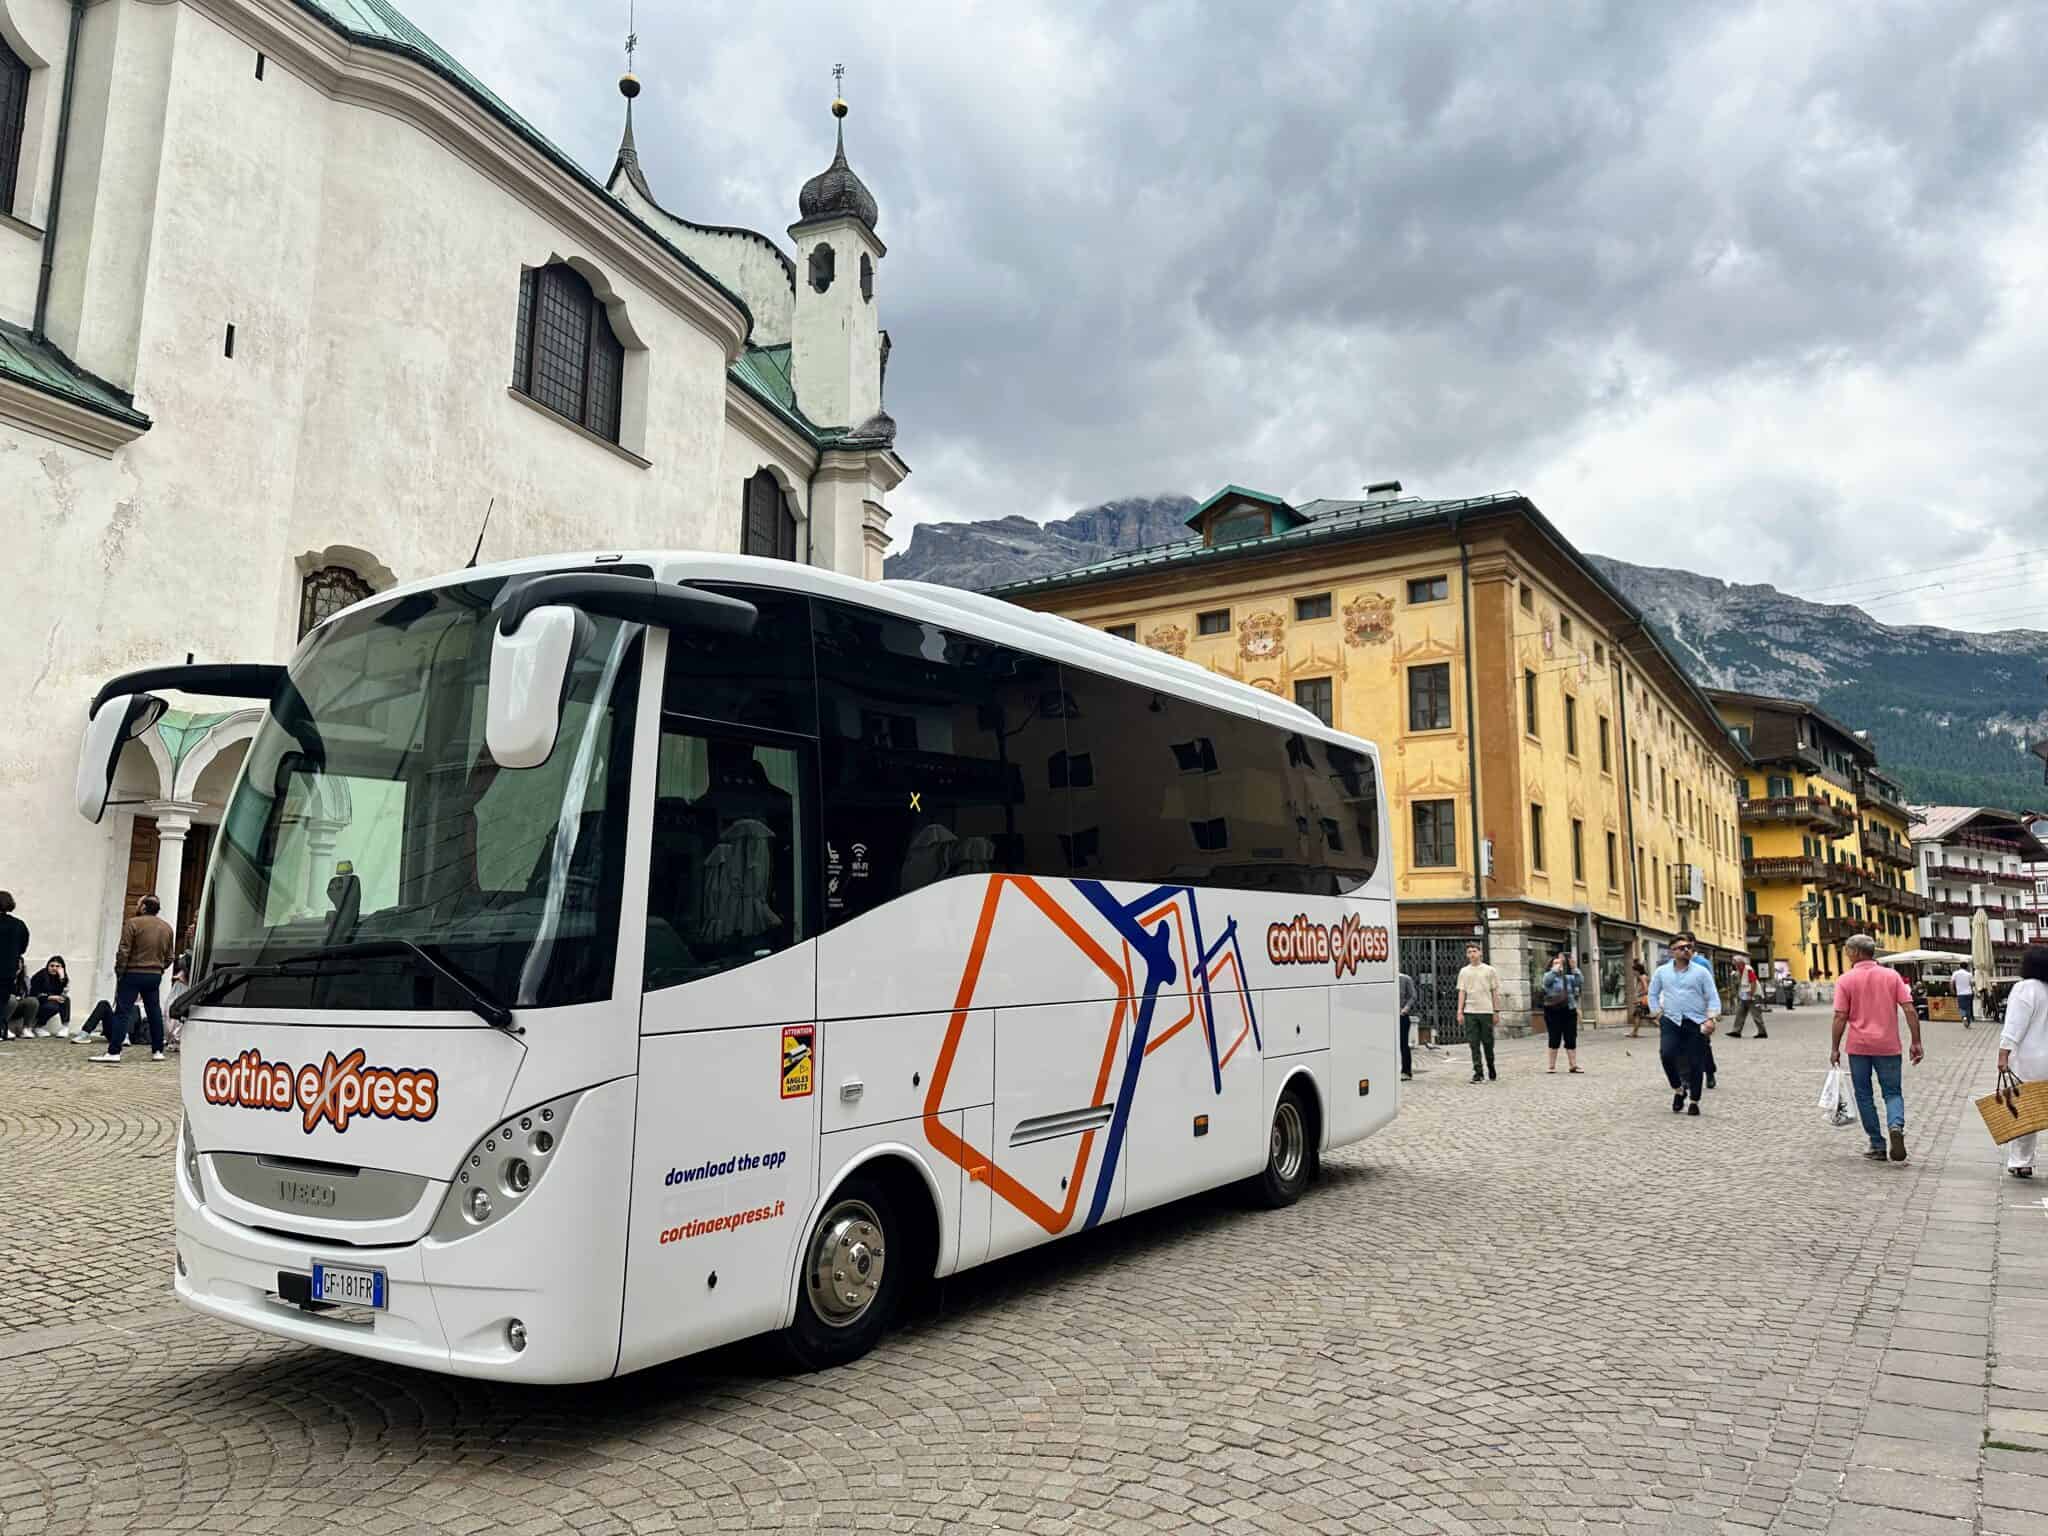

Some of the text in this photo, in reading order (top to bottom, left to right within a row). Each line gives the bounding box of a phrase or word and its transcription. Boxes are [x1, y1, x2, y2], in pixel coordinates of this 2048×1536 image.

[1267, 914, 1329, 963] cortina
[204, 1049, 293, 1110] cortina
[786, 1075, 808, 1085] ANGLES
[786, 1083, 808, 1093] MORTS
[664, 1151, 786, 1186] download the app
[659, 1200, 785, 1244] cortinaexpress.it
